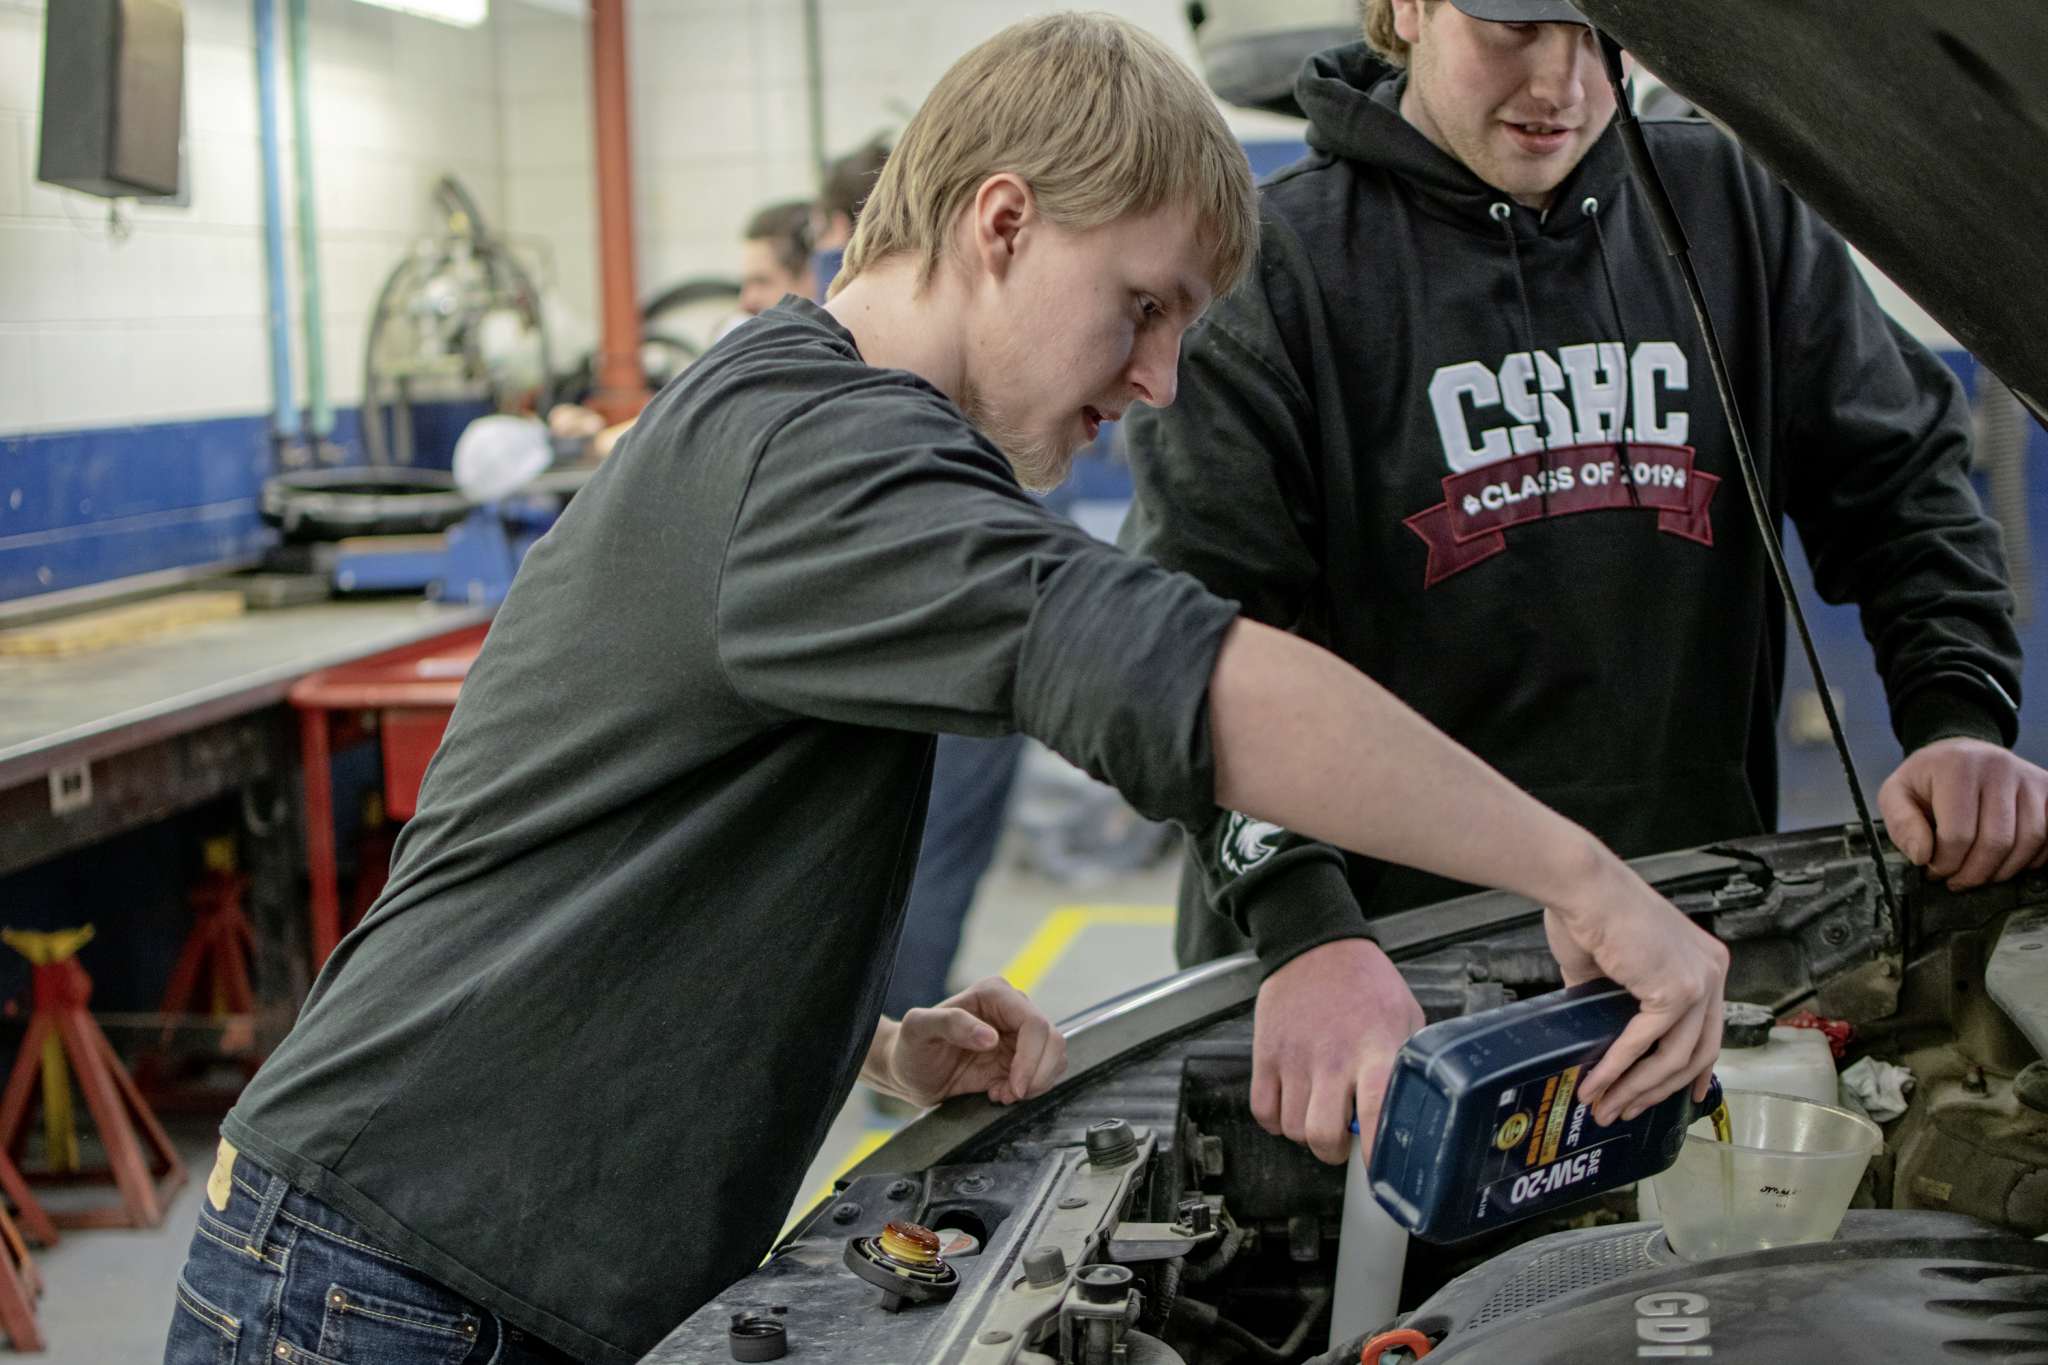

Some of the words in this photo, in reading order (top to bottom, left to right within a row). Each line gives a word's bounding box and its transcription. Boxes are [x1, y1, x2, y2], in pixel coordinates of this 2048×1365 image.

[1428, 341, 1689, 475] CSHC
[1480, 466, 1575, 509] CLASS
[1580, 461, 1615, 485] OF
[1511, 1152, 1589, 1205] 5W-20
[1586, 1148, 1602, 1177] SAE
